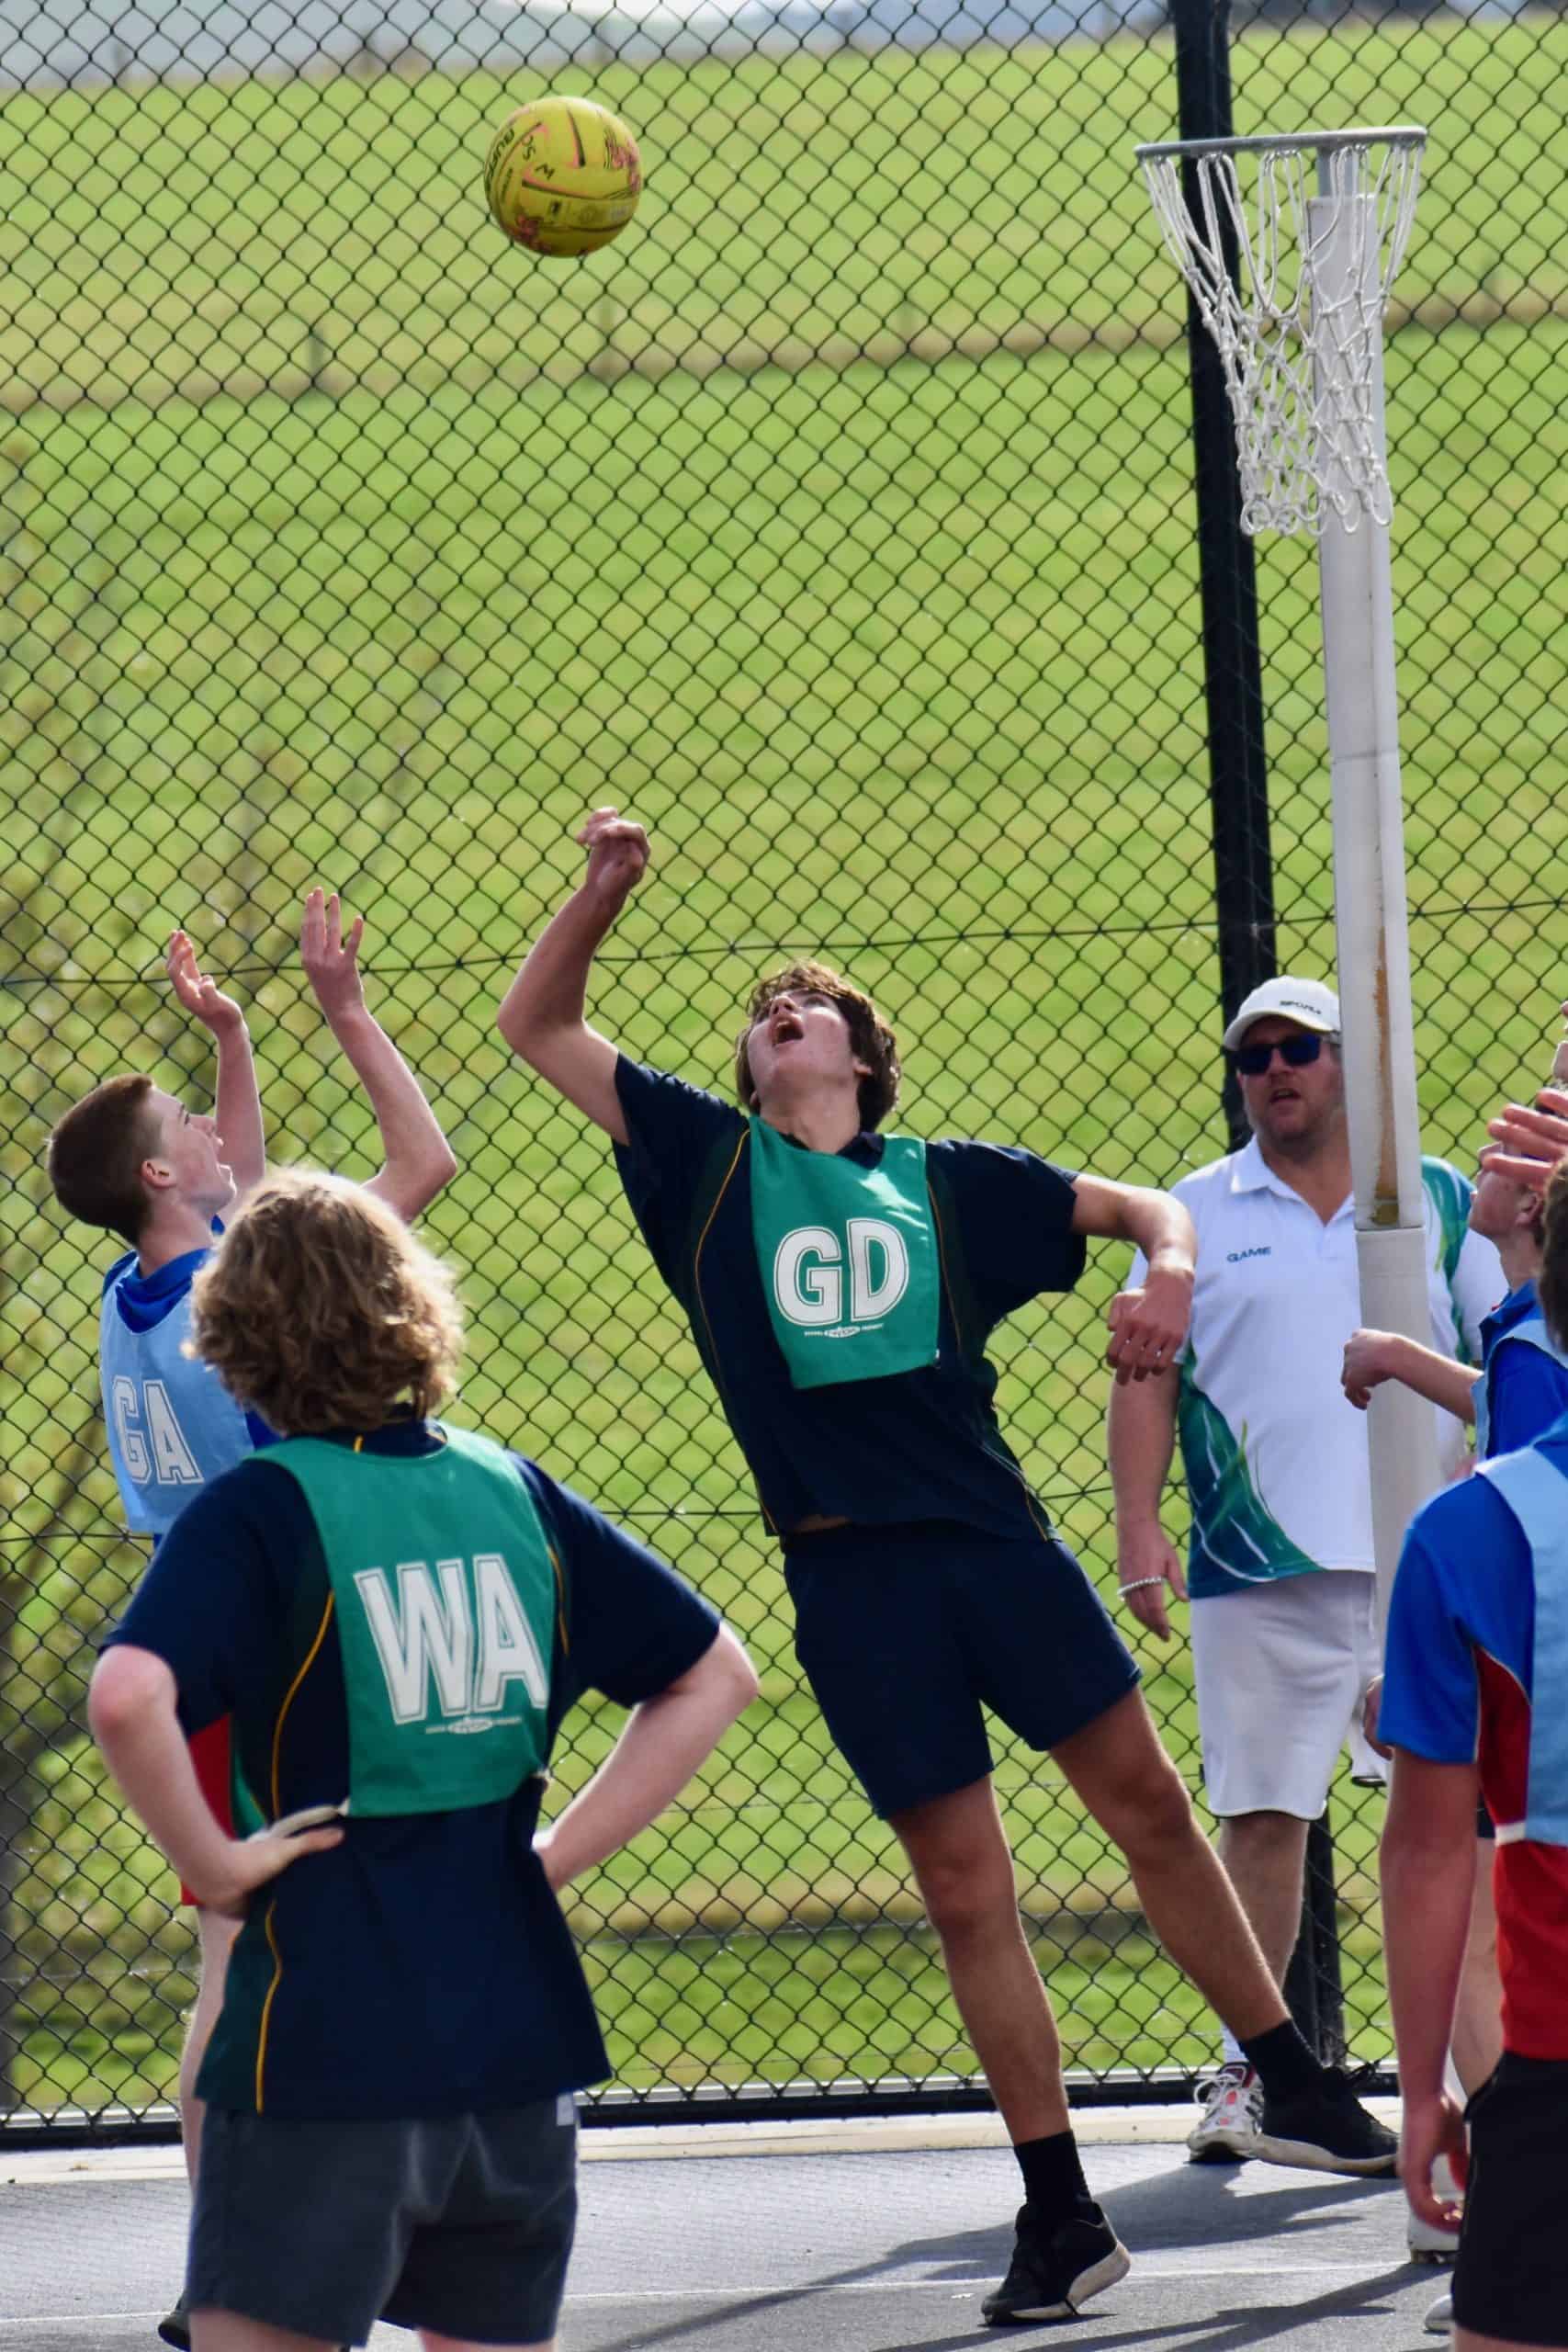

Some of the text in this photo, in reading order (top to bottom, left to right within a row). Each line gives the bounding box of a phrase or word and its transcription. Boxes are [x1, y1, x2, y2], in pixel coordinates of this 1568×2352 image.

[773, 1217, 909, 1326] GD
[1226, 1246, 1272, 1263] GAME
[112, 1375, 205, 1484] GA
[353, 1553, 549, 1724] WA
